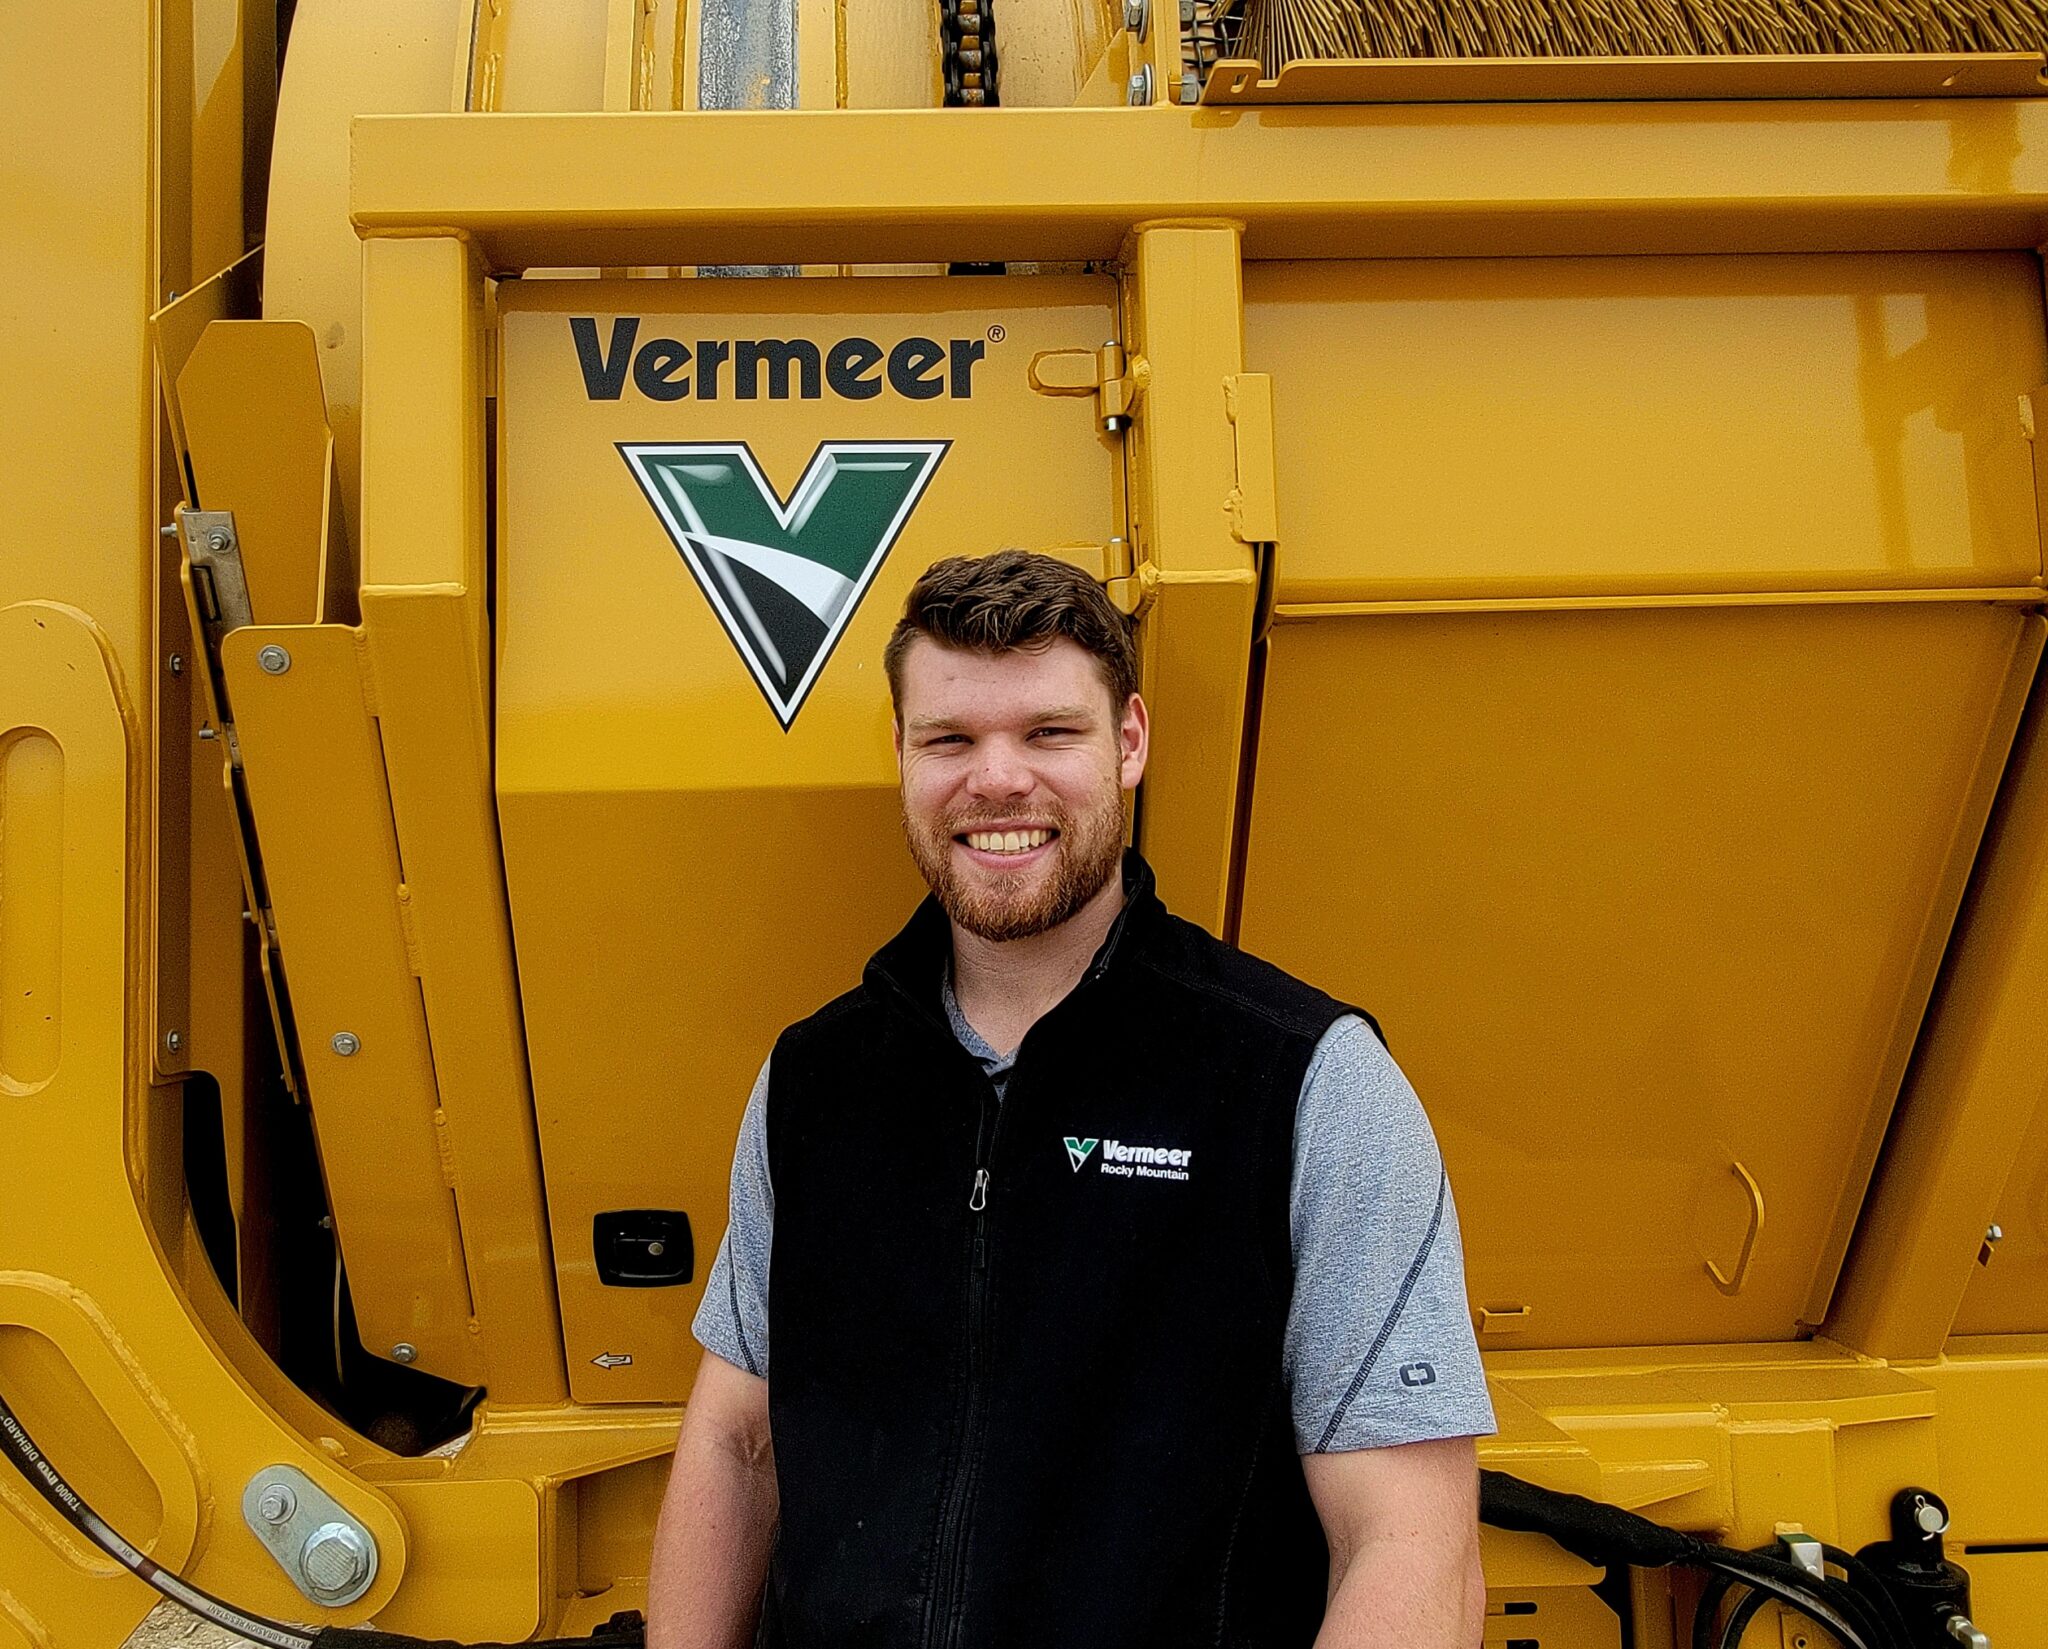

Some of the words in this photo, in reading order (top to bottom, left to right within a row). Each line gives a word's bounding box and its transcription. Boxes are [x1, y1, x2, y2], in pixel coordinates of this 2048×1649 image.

[1103, 1140, 1192, 1167] Vermeer
[1101, 1163, 1134, 1178] Rocky
[1136, 1166, 1189, 1181] Mountain
[3, 1416, 39, 1462] DIEHARD
[54, 1483, 81, 1512] T3000
[206, 1604, 245, 1628] RESISTANT
[245, 1622, 284, 1643] ABRASION
